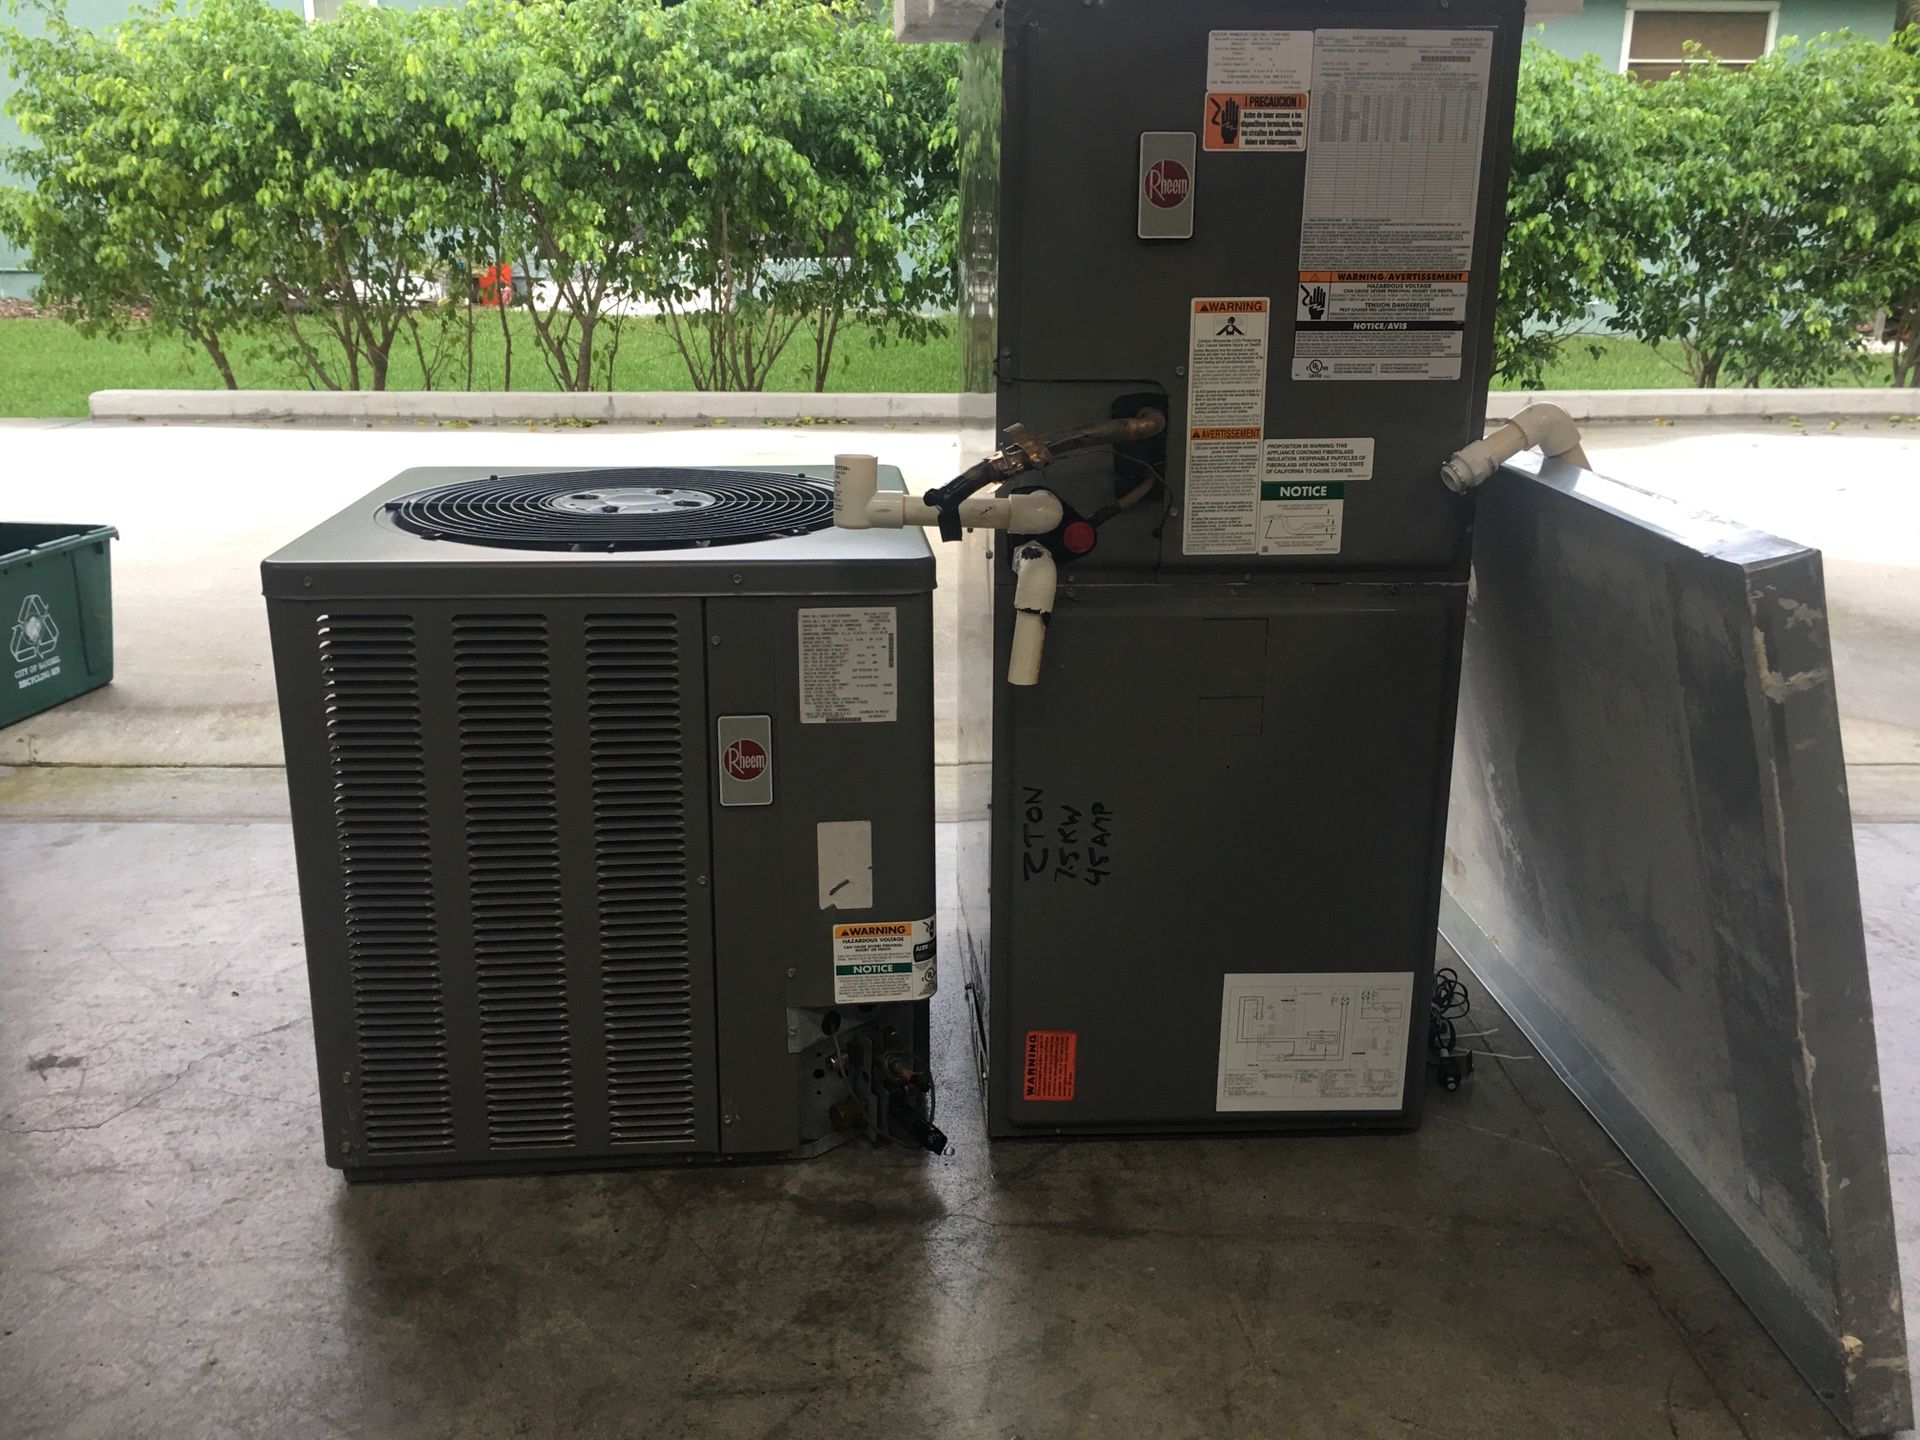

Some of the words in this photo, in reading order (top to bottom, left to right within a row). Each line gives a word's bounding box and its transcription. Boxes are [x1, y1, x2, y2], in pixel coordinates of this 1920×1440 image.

[1149, 160, 1188, 201] Rheem
[1337, 272, 1463, 281] WARNING/AVERTISSEMENT
[1208, 302, 1263, 312] WARNING
[1353, 322, 1408, 330] NOTICE/AVIS
[1200, 428, 1261, 440] AVERTISSEMENT
[1279, 486, 1328, 497] NOTICE
[728, 740, 765, 775] Rheem
[1091, 802, 1114, 847] AMP
[849, 925, 906, 937] WARNING
[853, 964, 894, 974] NOTICE
[1026, 1034, 1037, 1096] WARNING
